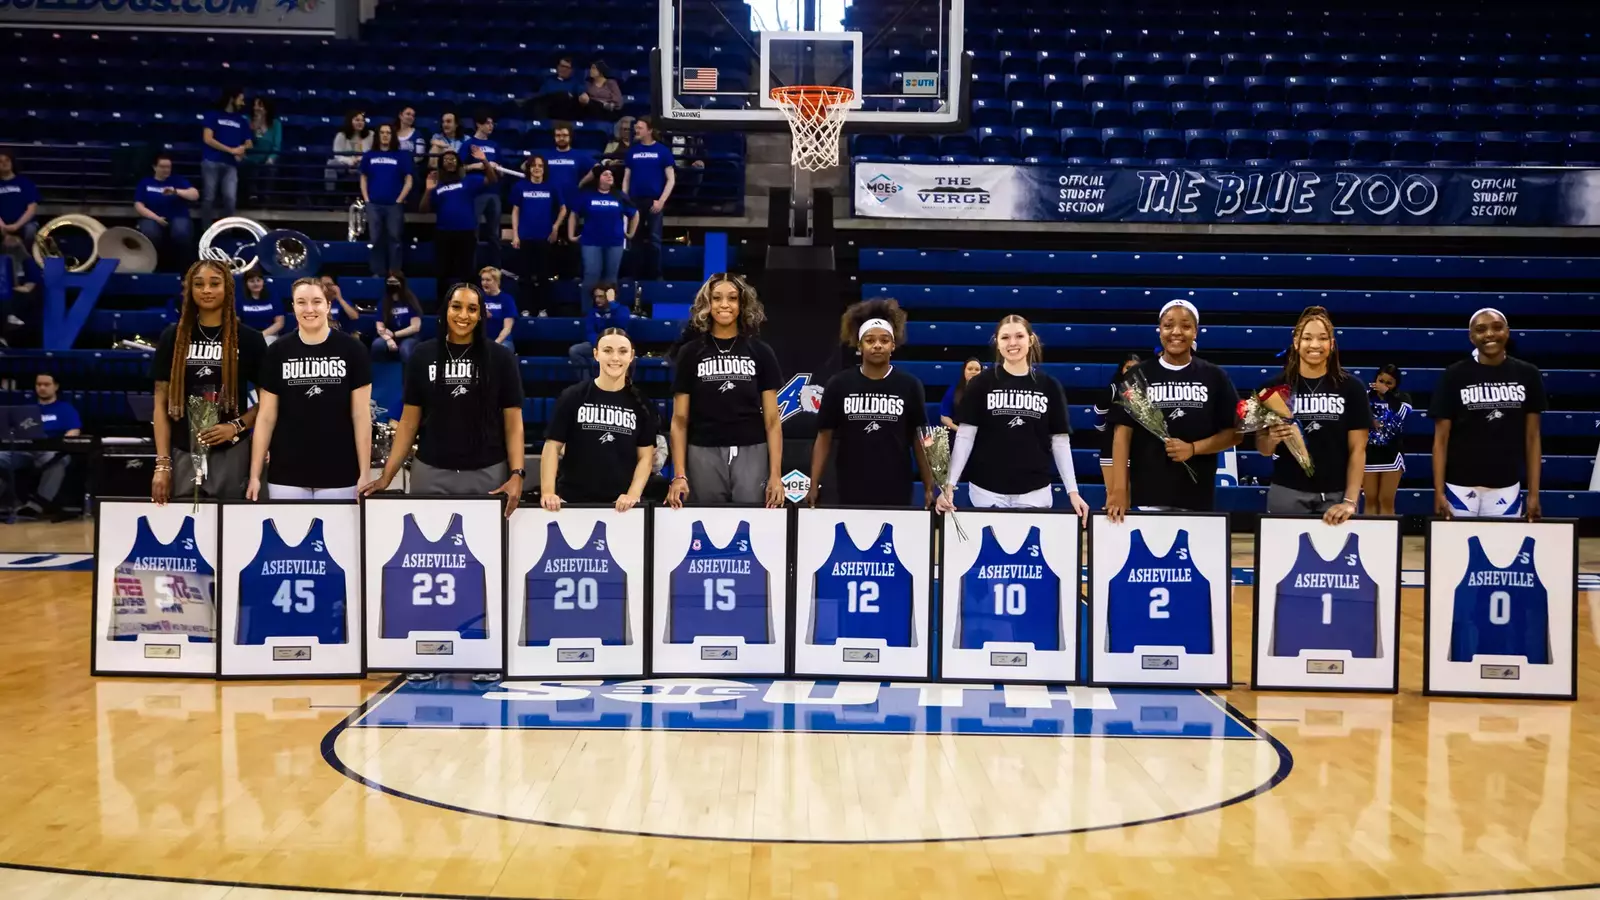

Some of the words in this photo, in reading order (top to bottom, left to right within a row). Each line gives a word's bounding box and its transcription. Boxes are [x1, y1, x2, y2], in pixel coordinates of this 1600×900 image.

[905, 79, 935, 87] SOUTH
[671, 111, 701, 119] SPALDING
[935, 177, 971, 186] THE
[1059, 175, 1104, 186] OFFICIAL
[1471, 179, 1517, 190] OFFICIAL
[917, 193, 990, 204] VERGE
[1059, 189, 1105, 200] STUDENT
[1137, 171, 1204, 213] THE
[1214, 172, 1321, 217] BLUE
[1331, 173, 1438, 215] ZOO
[1472, 192, 1519, 203] STUDENT
[1058, 202, 1104, 213] SECTION
[1471, 205, 1518, 217] SECTION
[282, 359, 347, 380] BULLDOGS
[697, 359, 757, 378] BULLDOGS
[986, 392, 1049, 414] BULLDOGS
[1460, 385, 1526, 405] BULLDOGS
[843, 397, 905, 416] BULLDOGS
[1292, 396, 1346, 414] ULLDOGS
[577, 405, 637, 430] BULLDOGS
[133, 556, 197, 573] ASHEVILLE
[261, 559, 326, 576] ASHEVILLE
[402, 553, 467, 569] ASHEVILLE
[544, 558, 609, 573] ASHEVILLE
[688, 559, 751, 575] ASHEVILLE
[832, 562, 895, 577] ASHEVILLE
[978, 564, 1043, 580] ASHEVILLE
[1127, 567, 1192, 583] ASHEVILLE
[1467, 570, 1535, 588] ASHEVILLE
[412, 572, 456, 606] 23
[1294, 573, 1360, 589] ASHEVILLE
[154, 575, 175, 609] 5
[272, 579, 316, 614] 45
[554, 577, 599, 610] 20
[703, 578, 736, 611] 15
[847, 580, 880, 613] 12
[993, 583, 1027, 616] 10
[1149, 587, 1170, 619] 2
[1321, 592, 1332, 625] 1
[1489, 590, 1511, 625] 0
